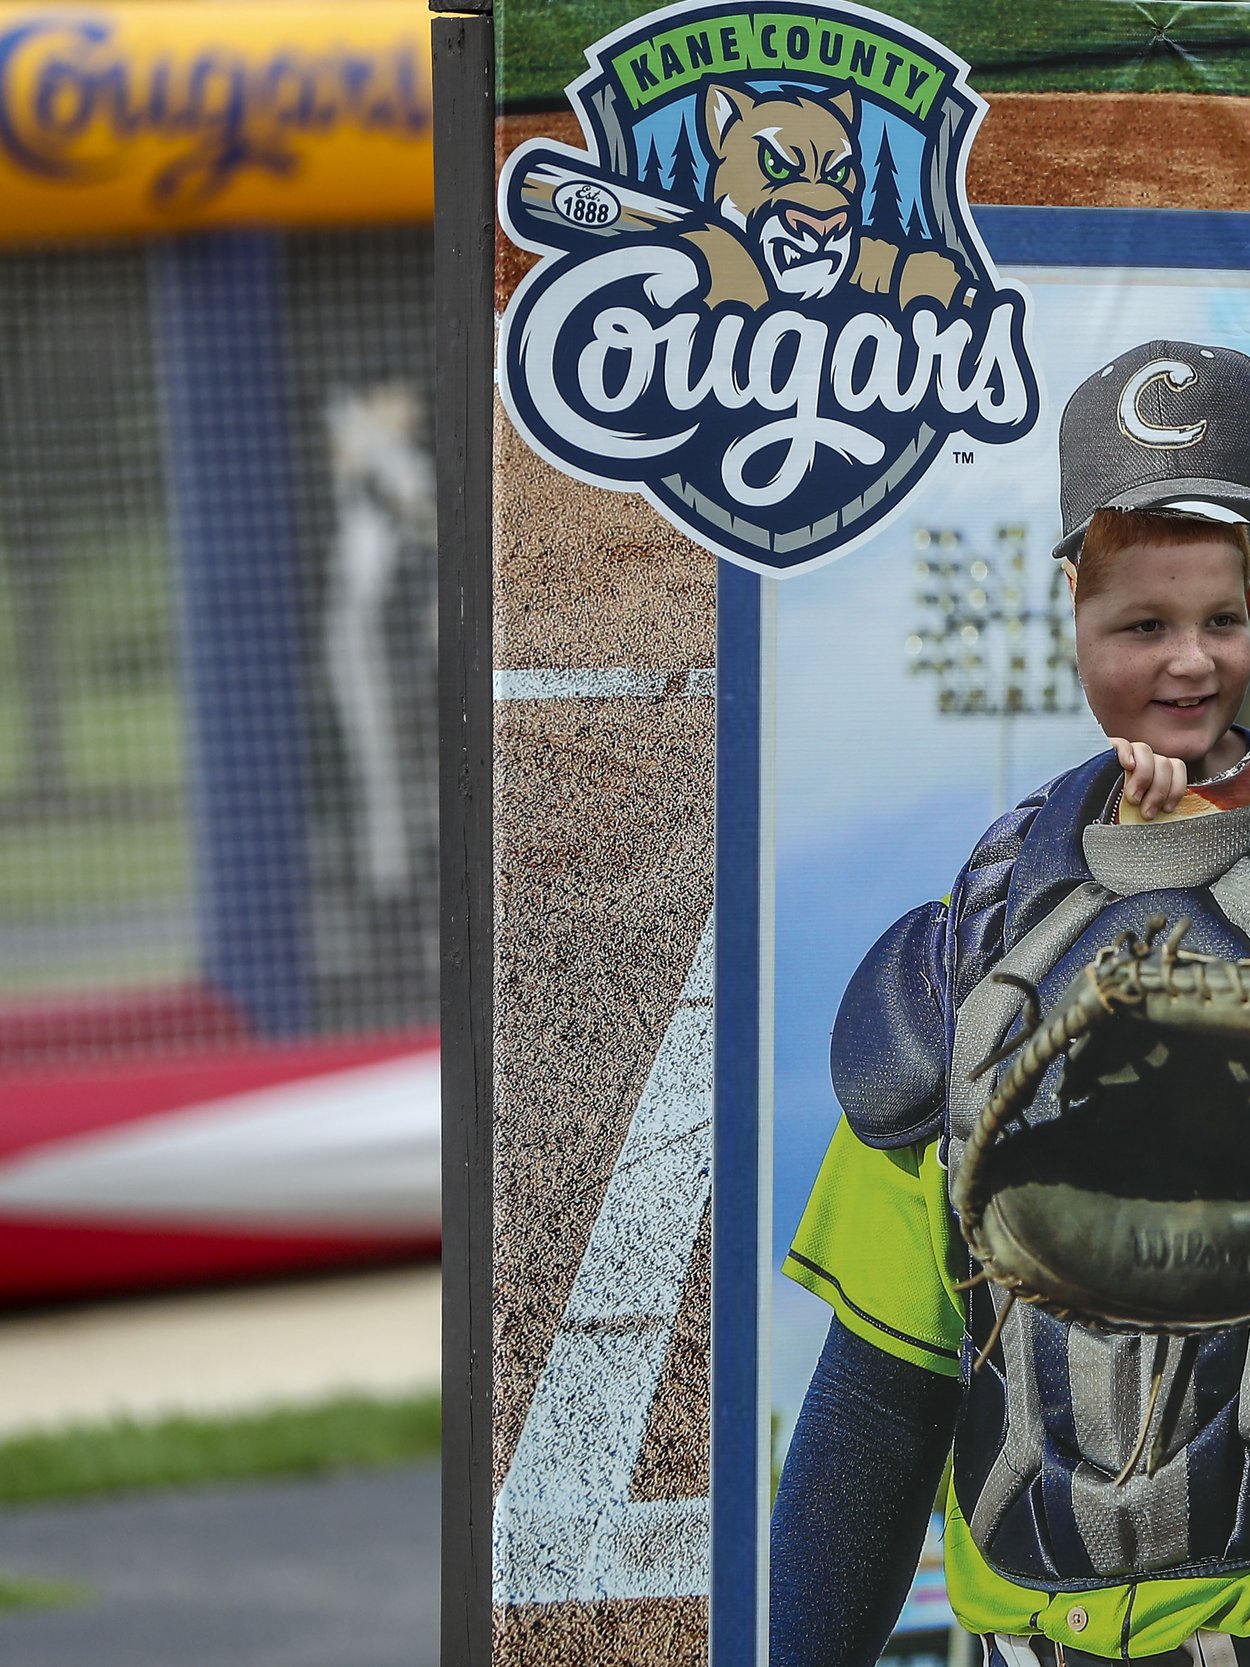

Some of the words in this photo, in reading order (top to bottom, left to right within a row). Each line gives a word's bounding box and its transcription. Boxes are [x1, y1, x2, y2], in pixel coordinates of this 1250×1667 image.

[629, 26, 740, 92] KANE
[761, 25, 930, 100] COUNTY
[563, 196, 609, 223] 1888
[575, 185, 601, 202] Est.
[518, 245, 1027, 508] Cougars
[1117, 357, 1207, 450] C
[952, 451, 974, 464] TM
